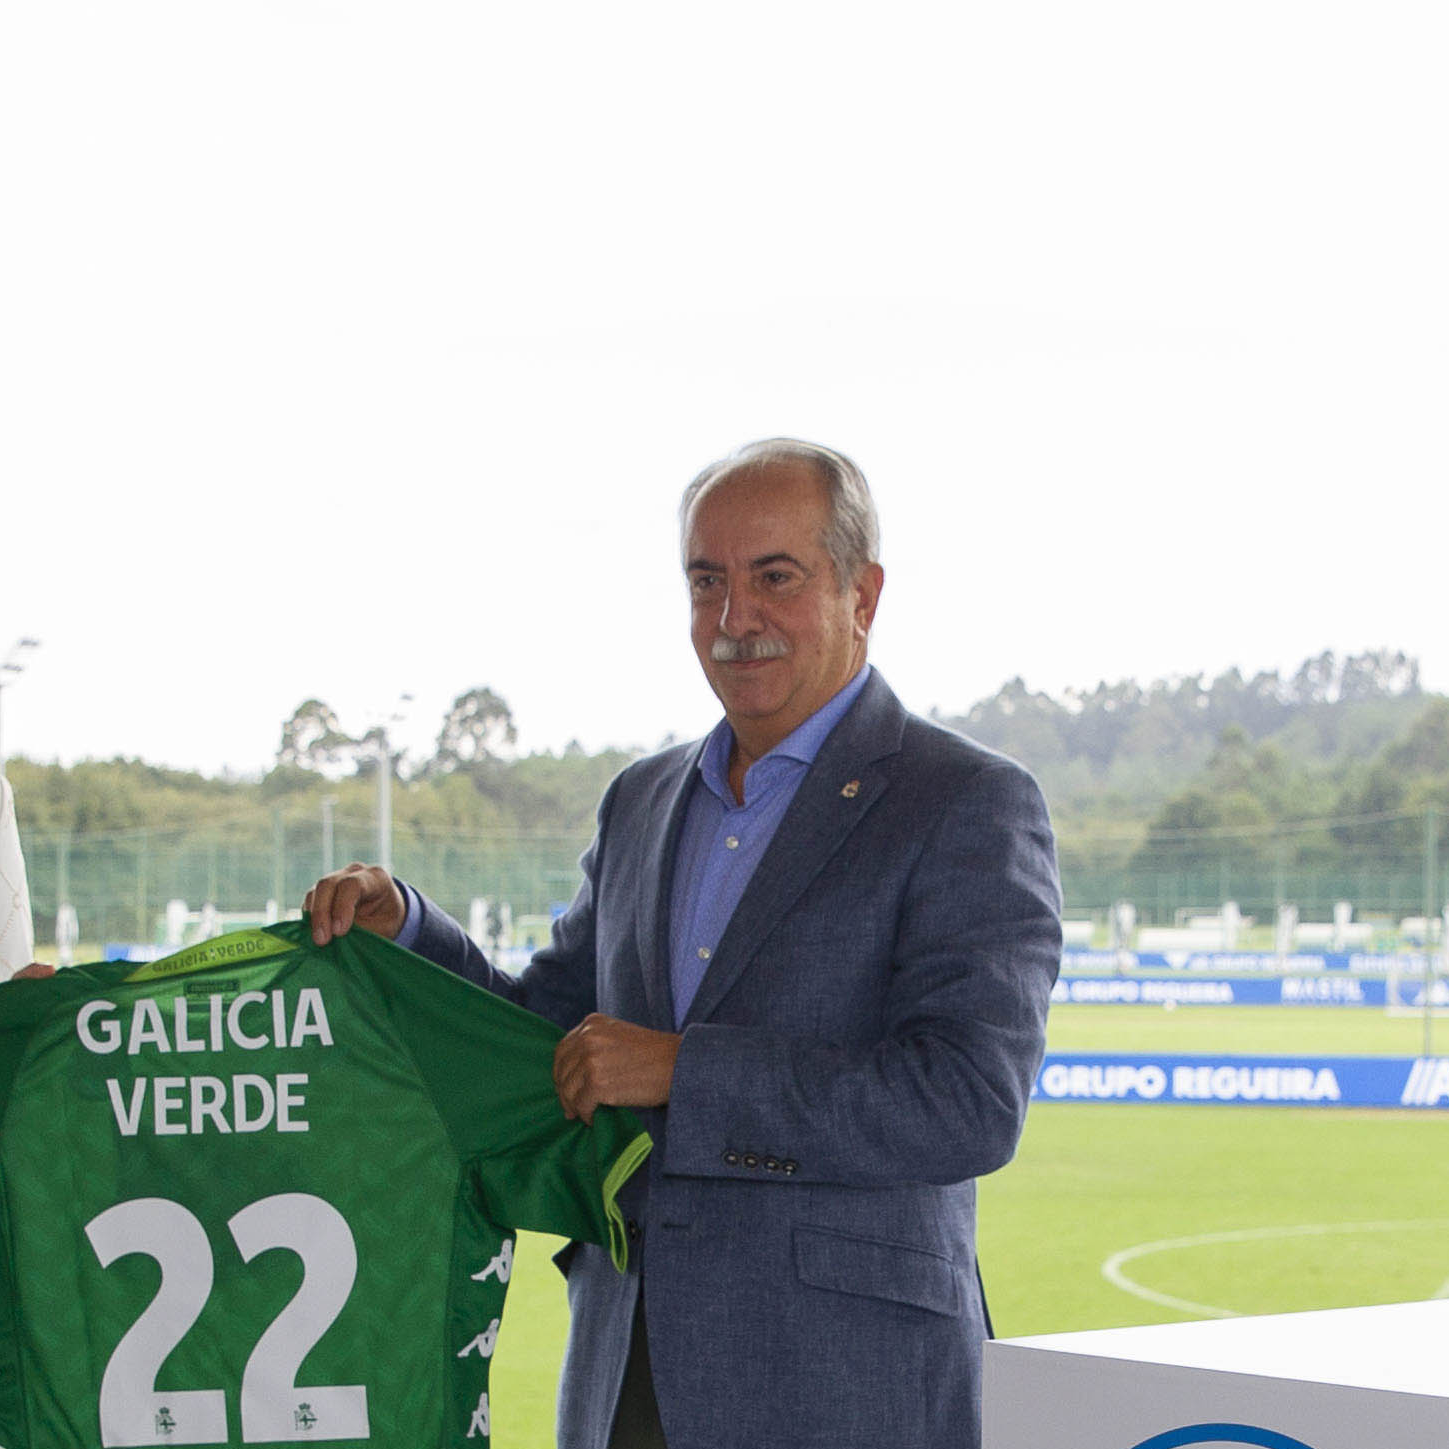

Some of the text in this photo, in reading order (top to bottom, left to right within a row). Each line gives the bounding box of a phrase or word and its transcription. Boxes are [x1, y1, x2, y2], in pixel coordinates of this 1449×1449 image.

[152, 939, 265, 973] GALICIA VERDE
[77, 987, 334, 1057] GALICIA
[106, 1073, 309, 1136] VERDE
[1042, 1064, 1341, 1101] GRUPO REGUEIRA
[84, 1192, 370, 1449] 22
